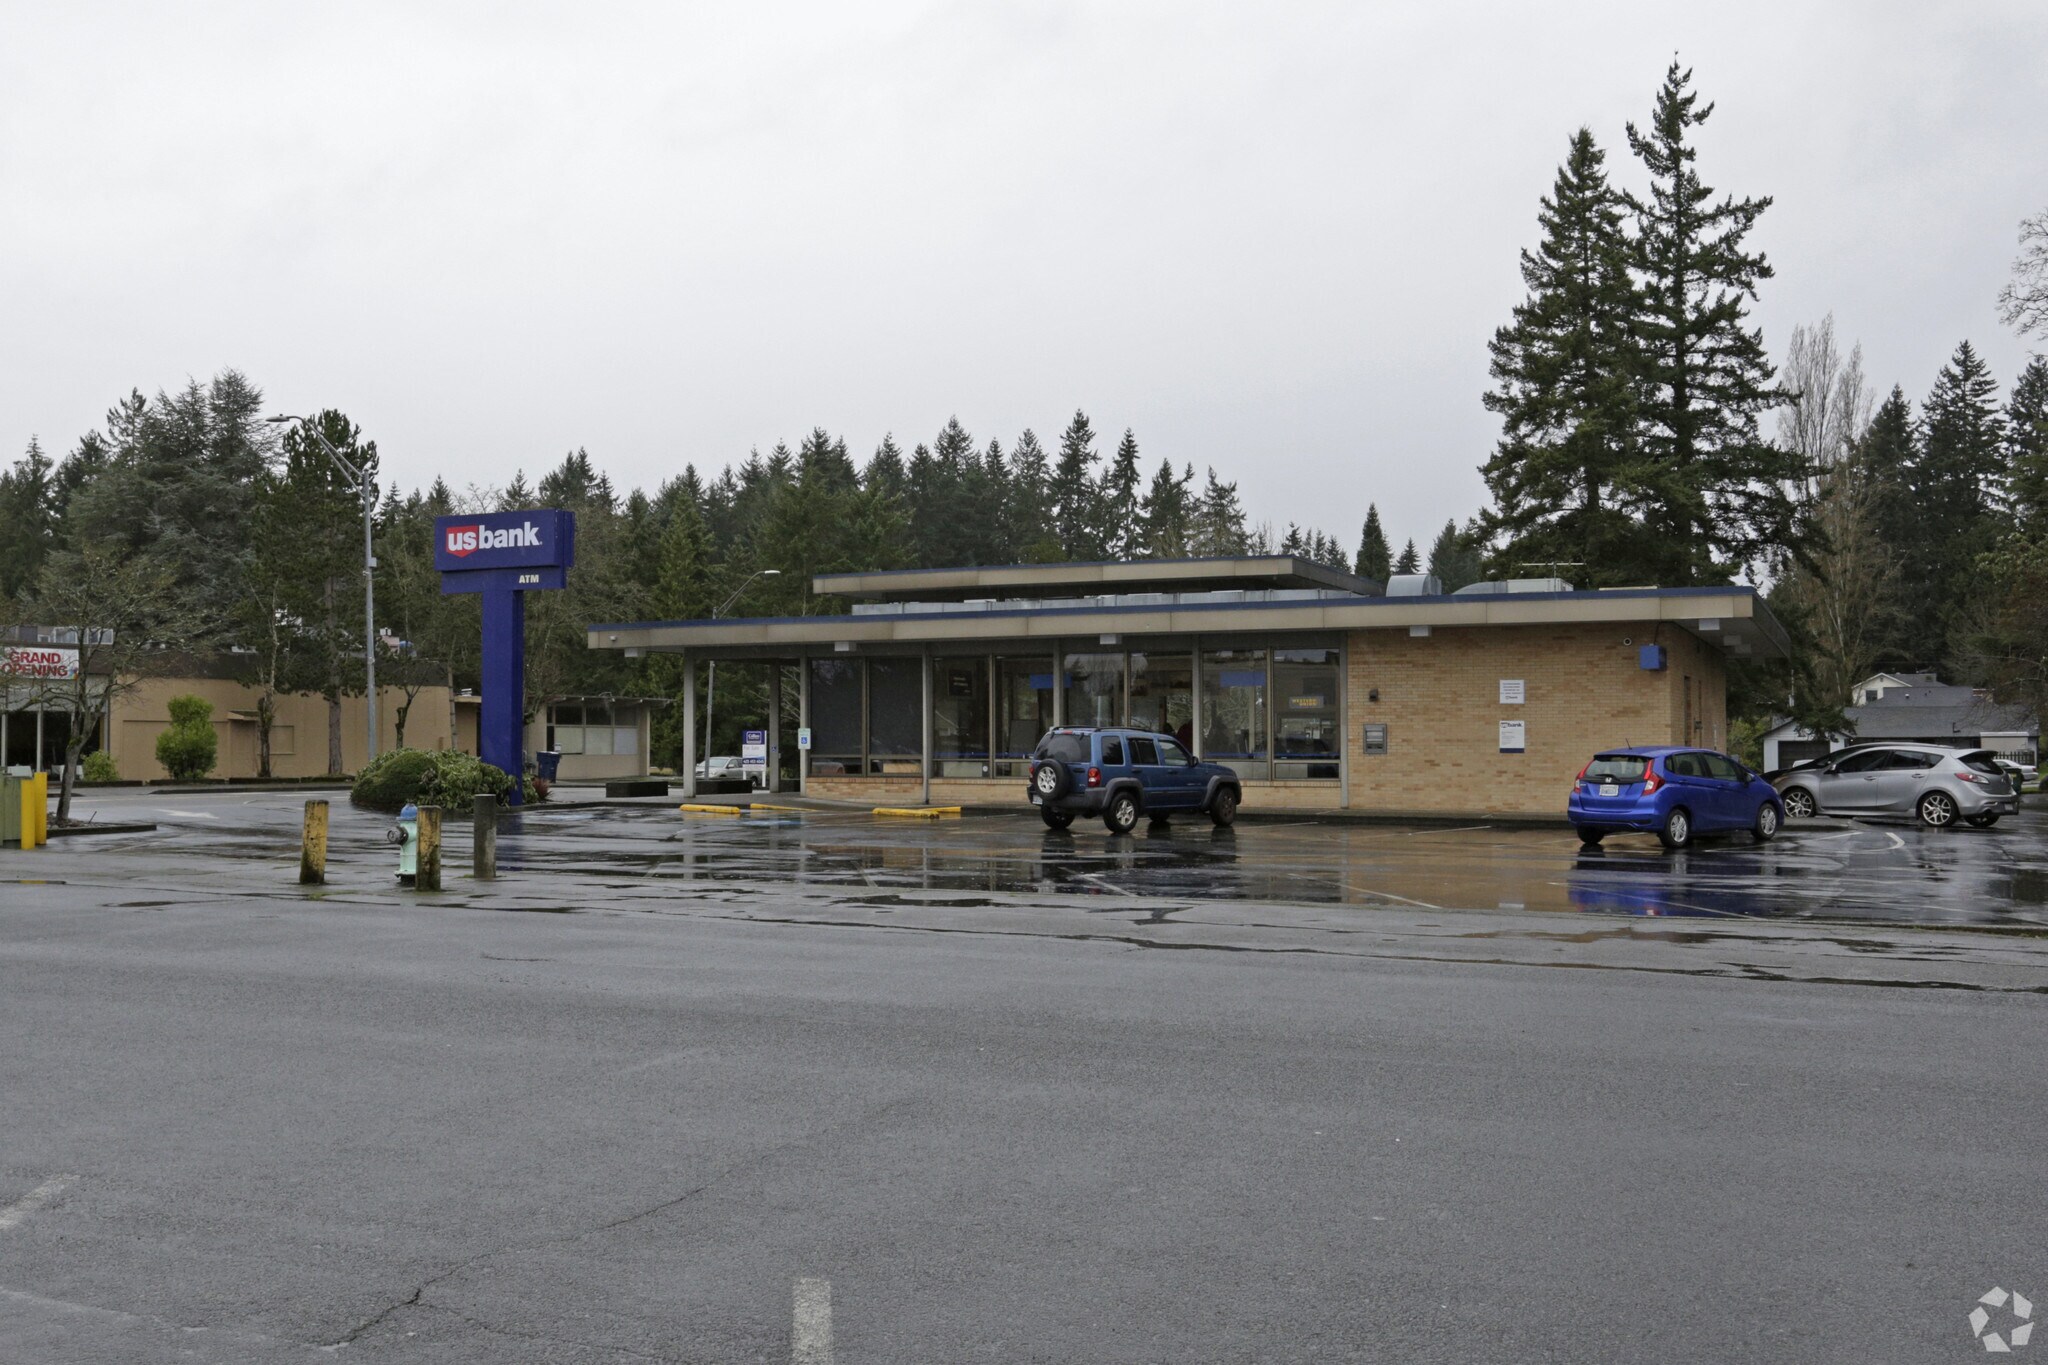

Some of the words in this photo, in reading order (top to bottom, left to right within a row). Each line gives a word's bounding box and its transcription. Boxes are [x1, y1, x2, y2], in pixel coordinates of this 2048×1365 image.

[518, 574, 539, 583] ATM
[9, 650, 62, 665] GRAND
[1, 662, 68, 677] OPENING
